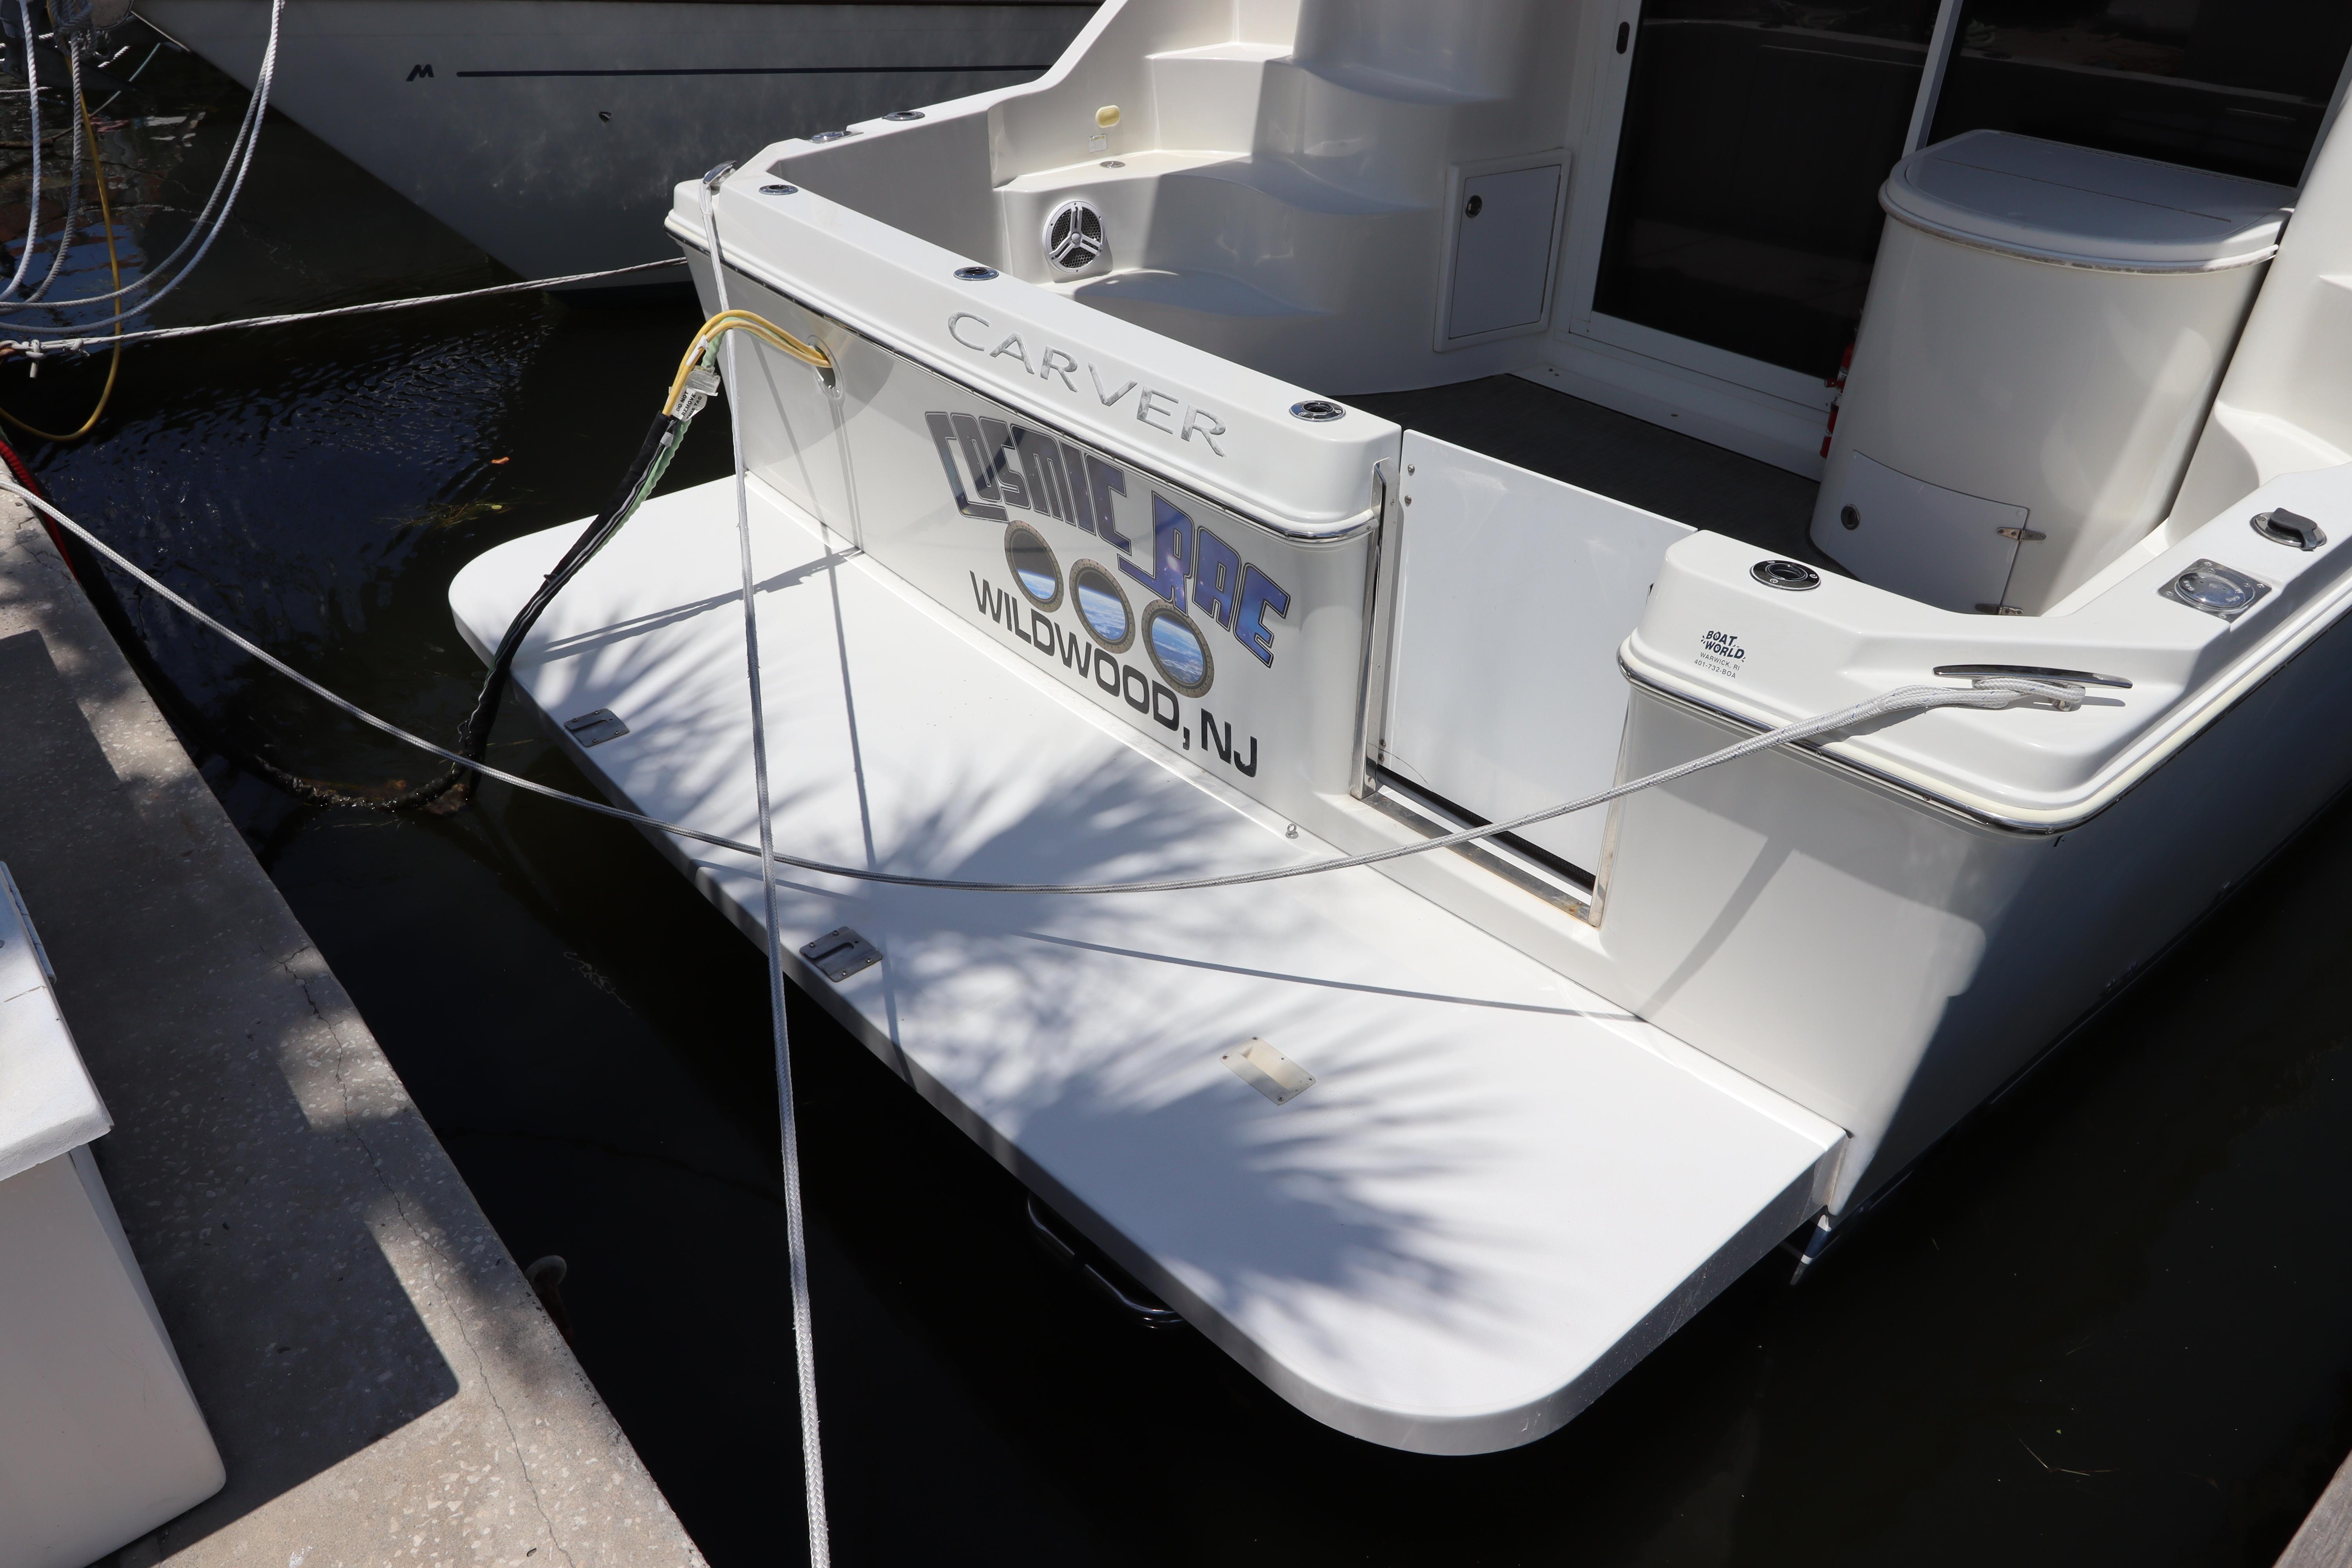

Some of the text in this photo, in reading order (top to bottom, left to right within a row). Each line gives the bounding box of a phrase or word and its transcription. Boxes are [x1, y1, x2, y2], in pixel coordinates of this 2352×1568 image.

[947, 311, 1227, 458] CARVER
[680, 392, 689, 403] NOT
[681, 393, 696, 416] REMOVE
[694, 396, 702, 407] TAG
[925, 410, 1132, 555] COSMIC
[1706, 630, 1737, 646] BOAT
[1704, 641, 1744, 659] WORLD
[1694, 659, 1737, 679] 401-732-BOA
[1700, 652, 1731, 668] WARWICK,
[969, 570, 1258, 777] WILDWOOD, NJ
